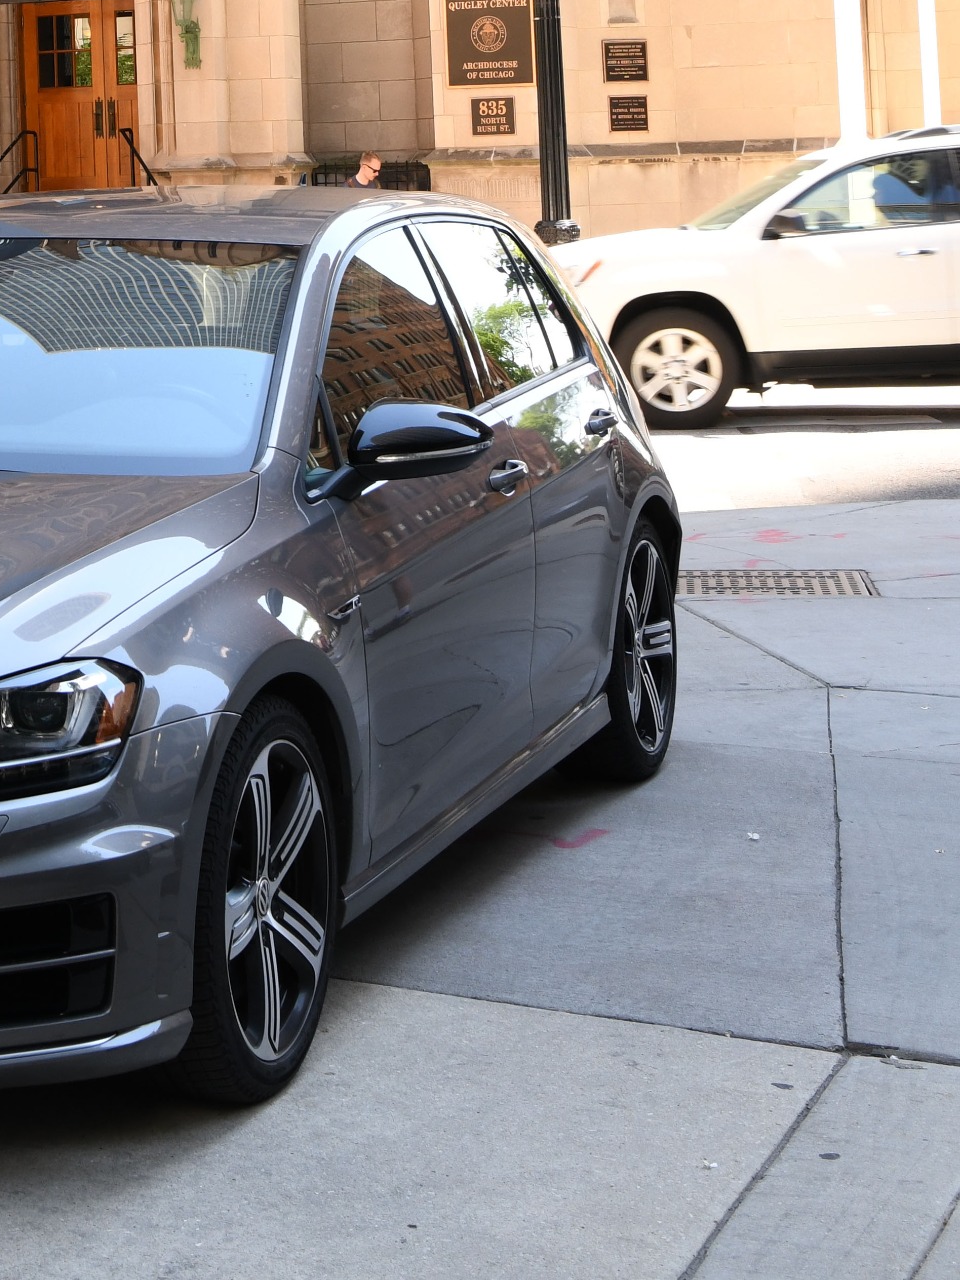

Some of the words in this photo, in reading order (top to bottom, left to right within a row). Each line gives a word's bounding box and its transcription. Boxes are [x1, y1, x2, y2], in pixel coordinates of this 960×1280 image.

[448, 0, 488, 12] QUIGLEY
[462, 60, 518, 70] ARCHDIOCESE
[467, 71, 478, 79] OF
[478, 70, 514, 79] CHICAGO
[479, 100, 507, 116] 835
[480, 116, 507, 125] NORTH
[477, 125, 497, 133] RUSH
[499, 124, 511, 132] ST.
